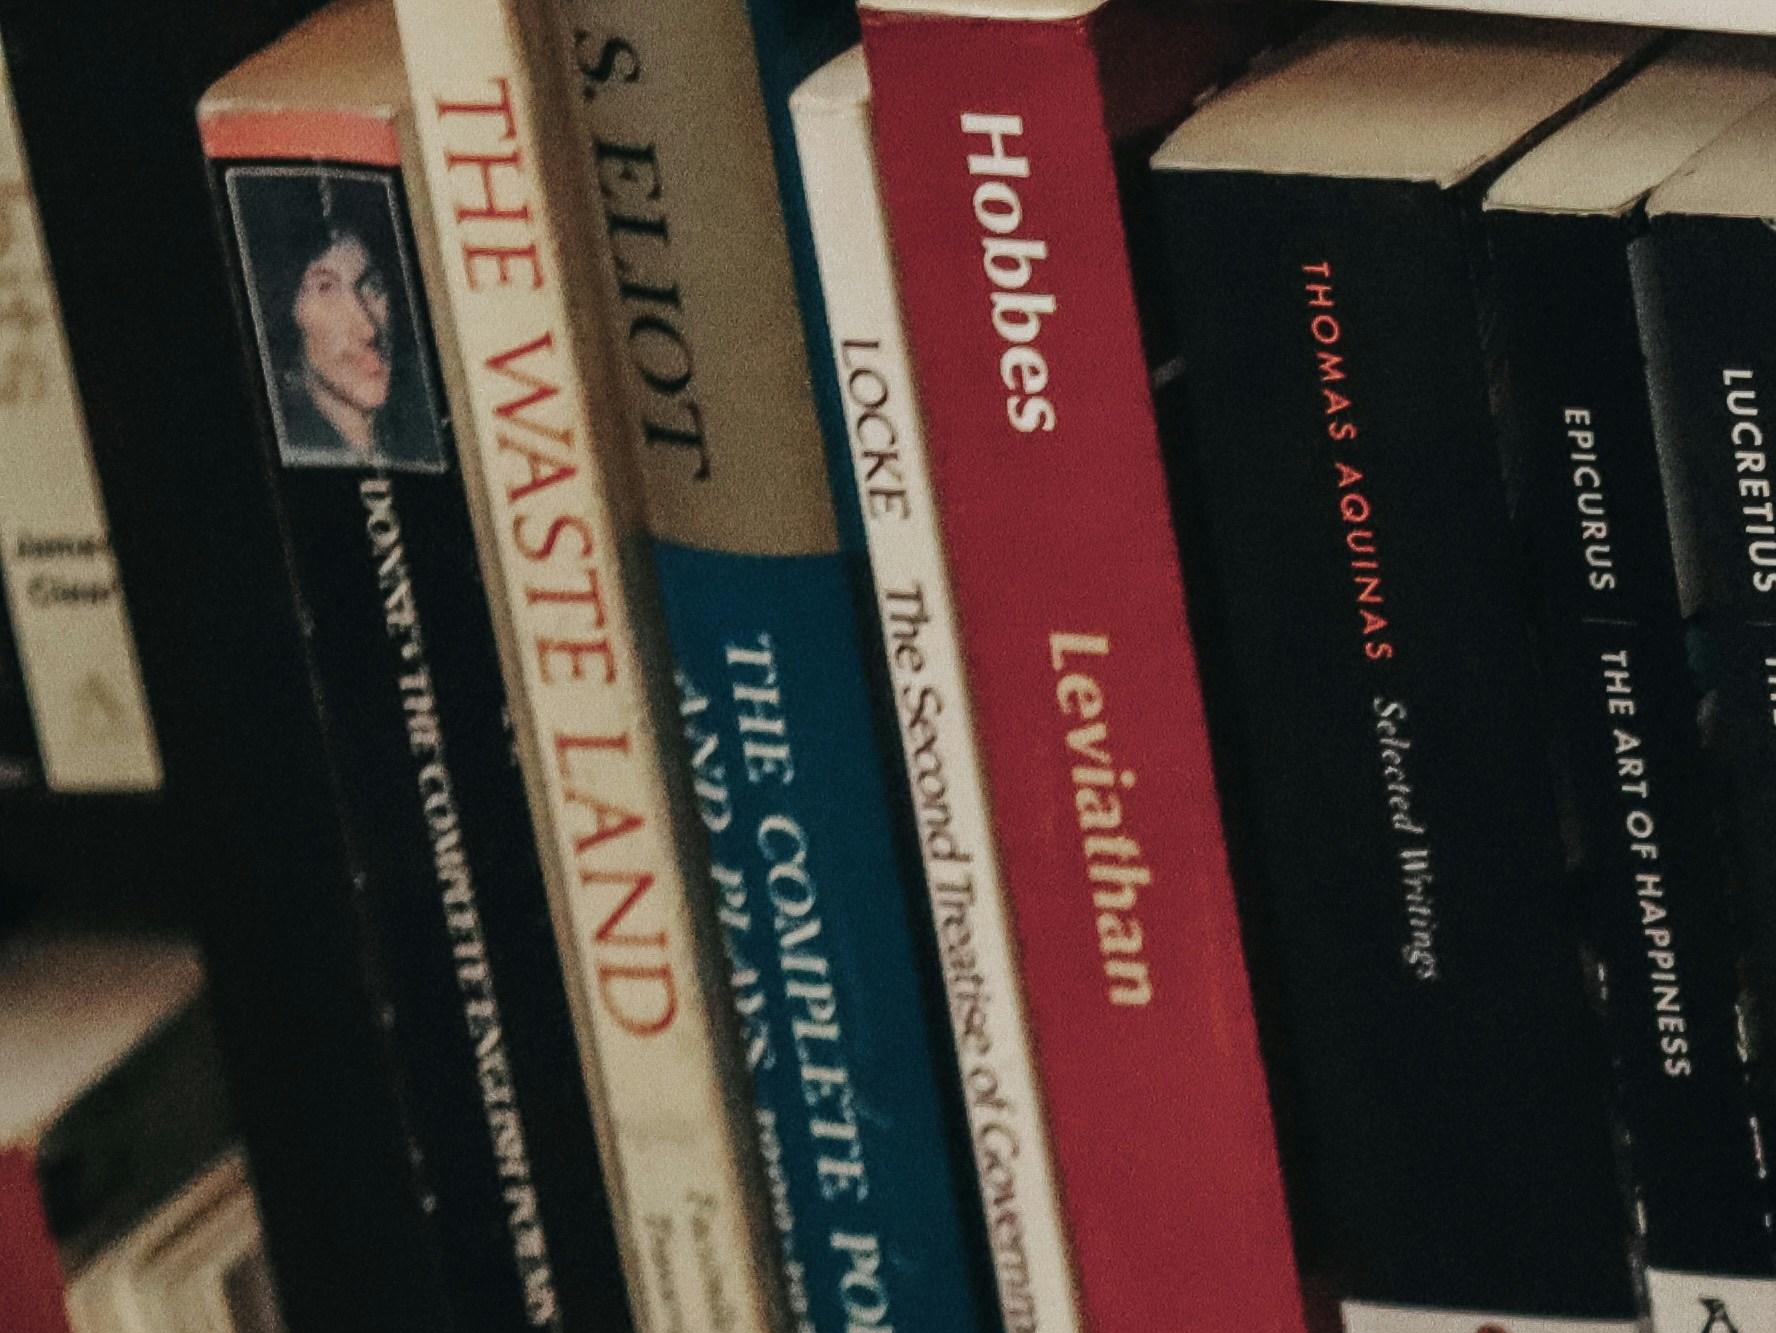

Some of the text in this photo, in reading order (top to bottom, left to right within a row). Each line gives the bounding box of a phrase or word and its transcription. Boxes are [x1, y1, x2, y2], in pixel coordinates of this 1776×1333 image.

[594, 138, 710, 482] ELIOT
[839, 337, 911, 521] LOCKE
[960, 111, 1057, 433] Hobbes
[437, 80, 679, 1037] THE WASTE LAND
[726, 633, 795, 784] THE
[884, 584, 928, 674] The
[1303, 261, 1442, 983] THOMAS AQUINAS Selected Writings
[899, 678, 970, 862] Second
[1049, 629, 1151, 1006] Leviathan
[1564, 406, 1692, 1079] EPICURUS THE ART OF HAPPINESS
[757, 819, 869, 1199] COMPLETE
[931, 867, 990, 1054] Treatise
[971, 1064, 1011, 1115] of
